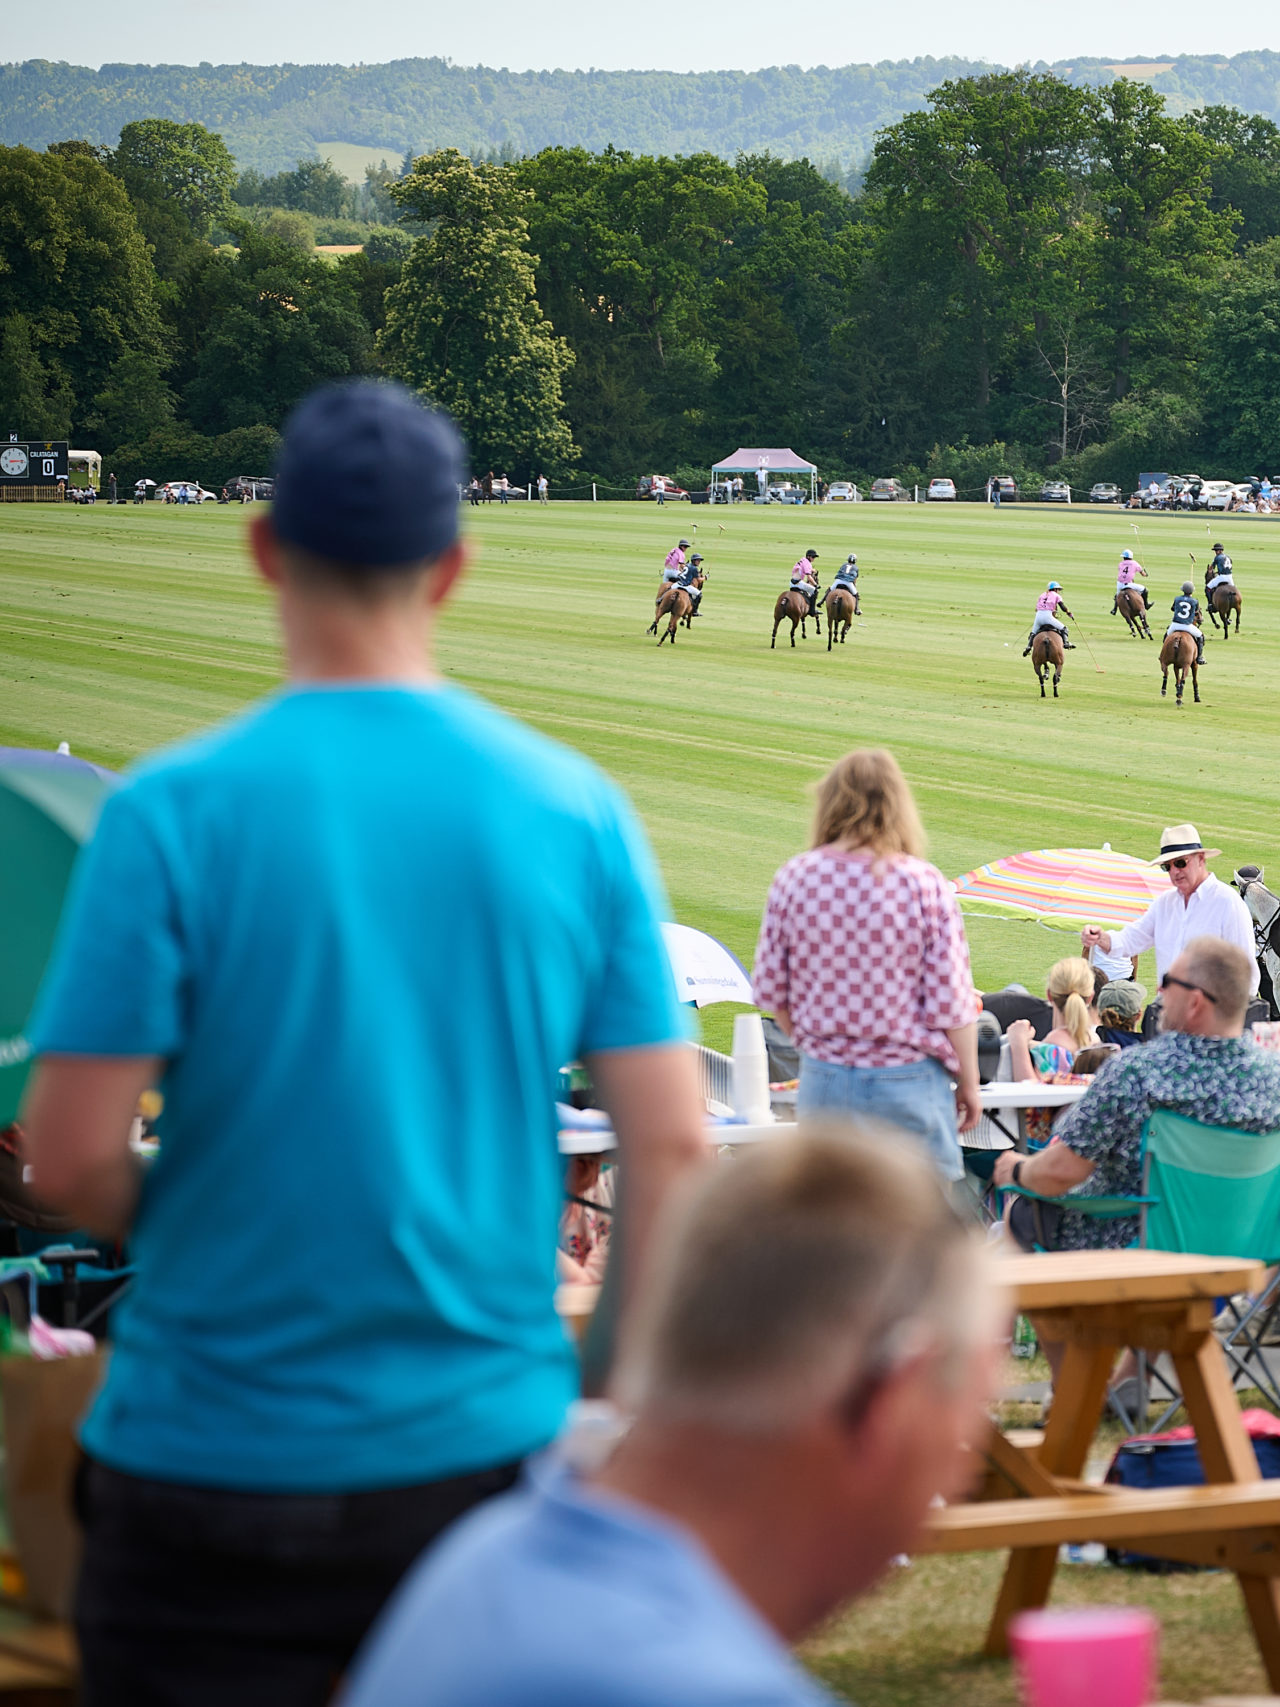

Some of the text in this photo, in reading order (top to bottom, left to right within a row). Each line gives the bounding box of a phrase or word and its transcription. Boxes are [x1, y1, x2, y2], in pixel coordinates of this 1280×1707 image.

[45, 461, 52, 474] 0
[1223, 556, 1232, 570] 4
[680, 566, 689, 579] 2
[1123, 566, 1129, 574] 4
[1177, 602, 1191, 619] 3
